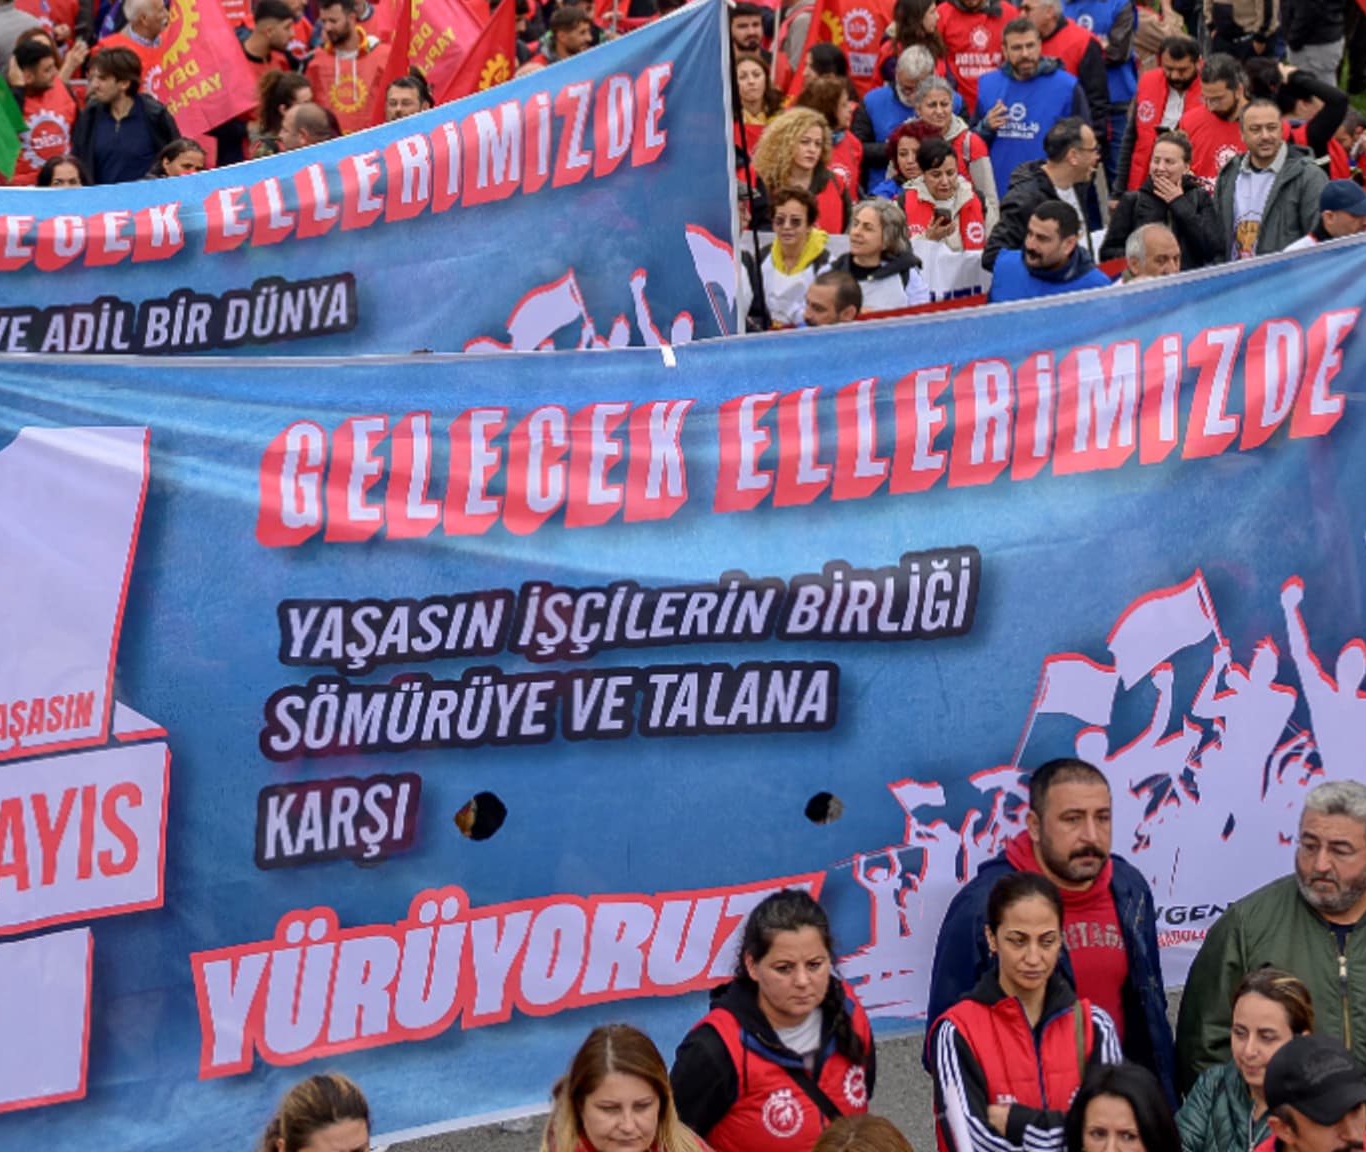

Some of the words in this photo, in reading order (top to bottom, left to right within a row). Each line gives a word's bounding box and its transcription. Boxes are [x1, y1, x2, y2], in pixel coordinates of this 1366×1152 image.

[204, 61, 673, 268] ELLERİMİZDE
[42, 301, 132, 353] ADİL
[144, 295, 213, 348] BİR
[223, 281, 351, 341] DÜNYA
[256, 397, 696, 546] GELECEK
[713, 305, 1362, 510] ELLERİMİZDE
[284, 596, 503, 671] YAŞASIN
[518, 576, 777, 656] İŞÇİLERİN
[788, 555, 976, 634] BİRLİĞİ
[269, 672, 560, 750] SÖMÜRÜYE
[569, 674, 630, 737] VE
[640, 666, 833, 732] TALANA
[260, 778, 415, 861] KARŞI
